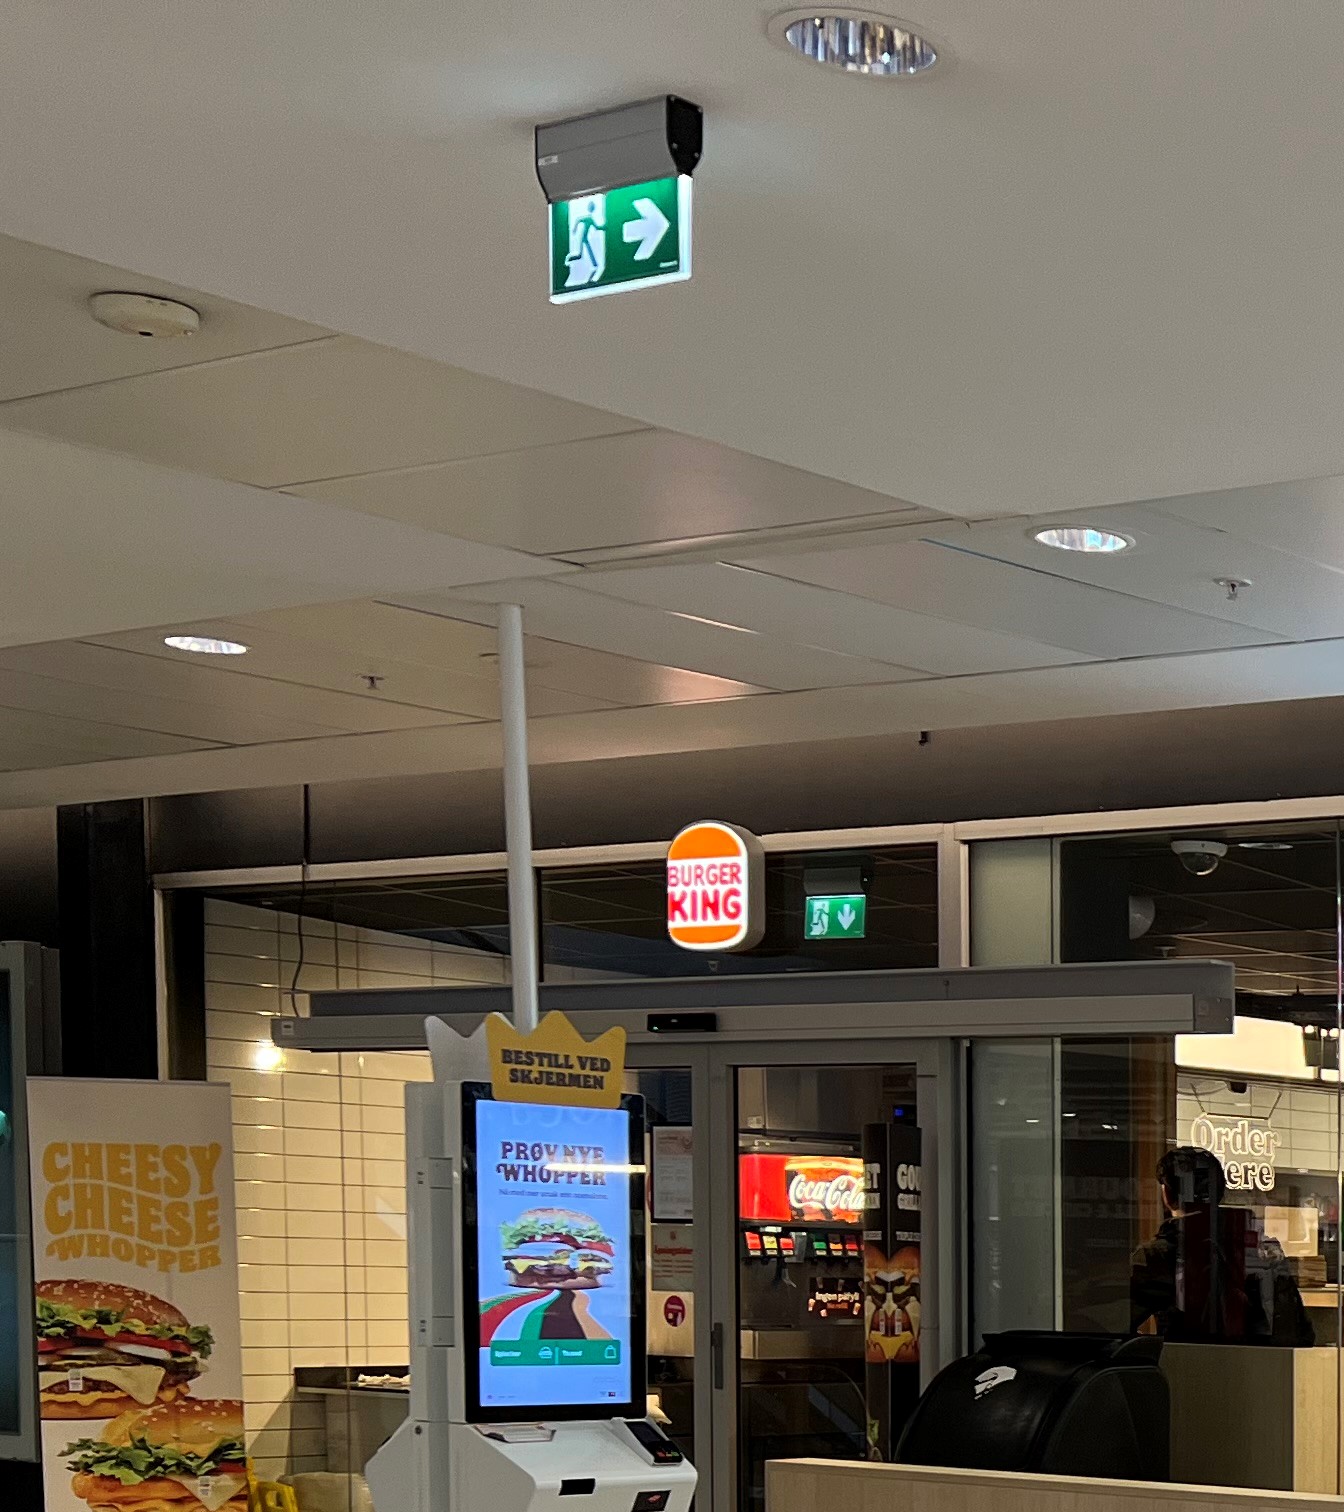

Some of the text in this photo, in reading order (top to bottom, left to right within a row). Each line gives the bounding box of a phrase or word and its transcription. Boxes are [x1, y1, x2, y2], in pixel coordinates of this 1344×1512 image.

[667, 862, 742, 887] BURGER
[669, 888, 742, 922] KING
[501, 1049, 611, 1072] BESTILL VED
[509, 1068, 604, 1090] SKJERMEN
[1191, 1113, 1282, 1157] Order
[42, 1141, 222, 1198] CHEESY
[501, 1141, 604, 1164] PRØV NYE
[1221, 1157, 1275, 1191] ere
[44, 1183, 221, 1247] CHEESE
[45, 1232, 222, 1273] WHOPPER
